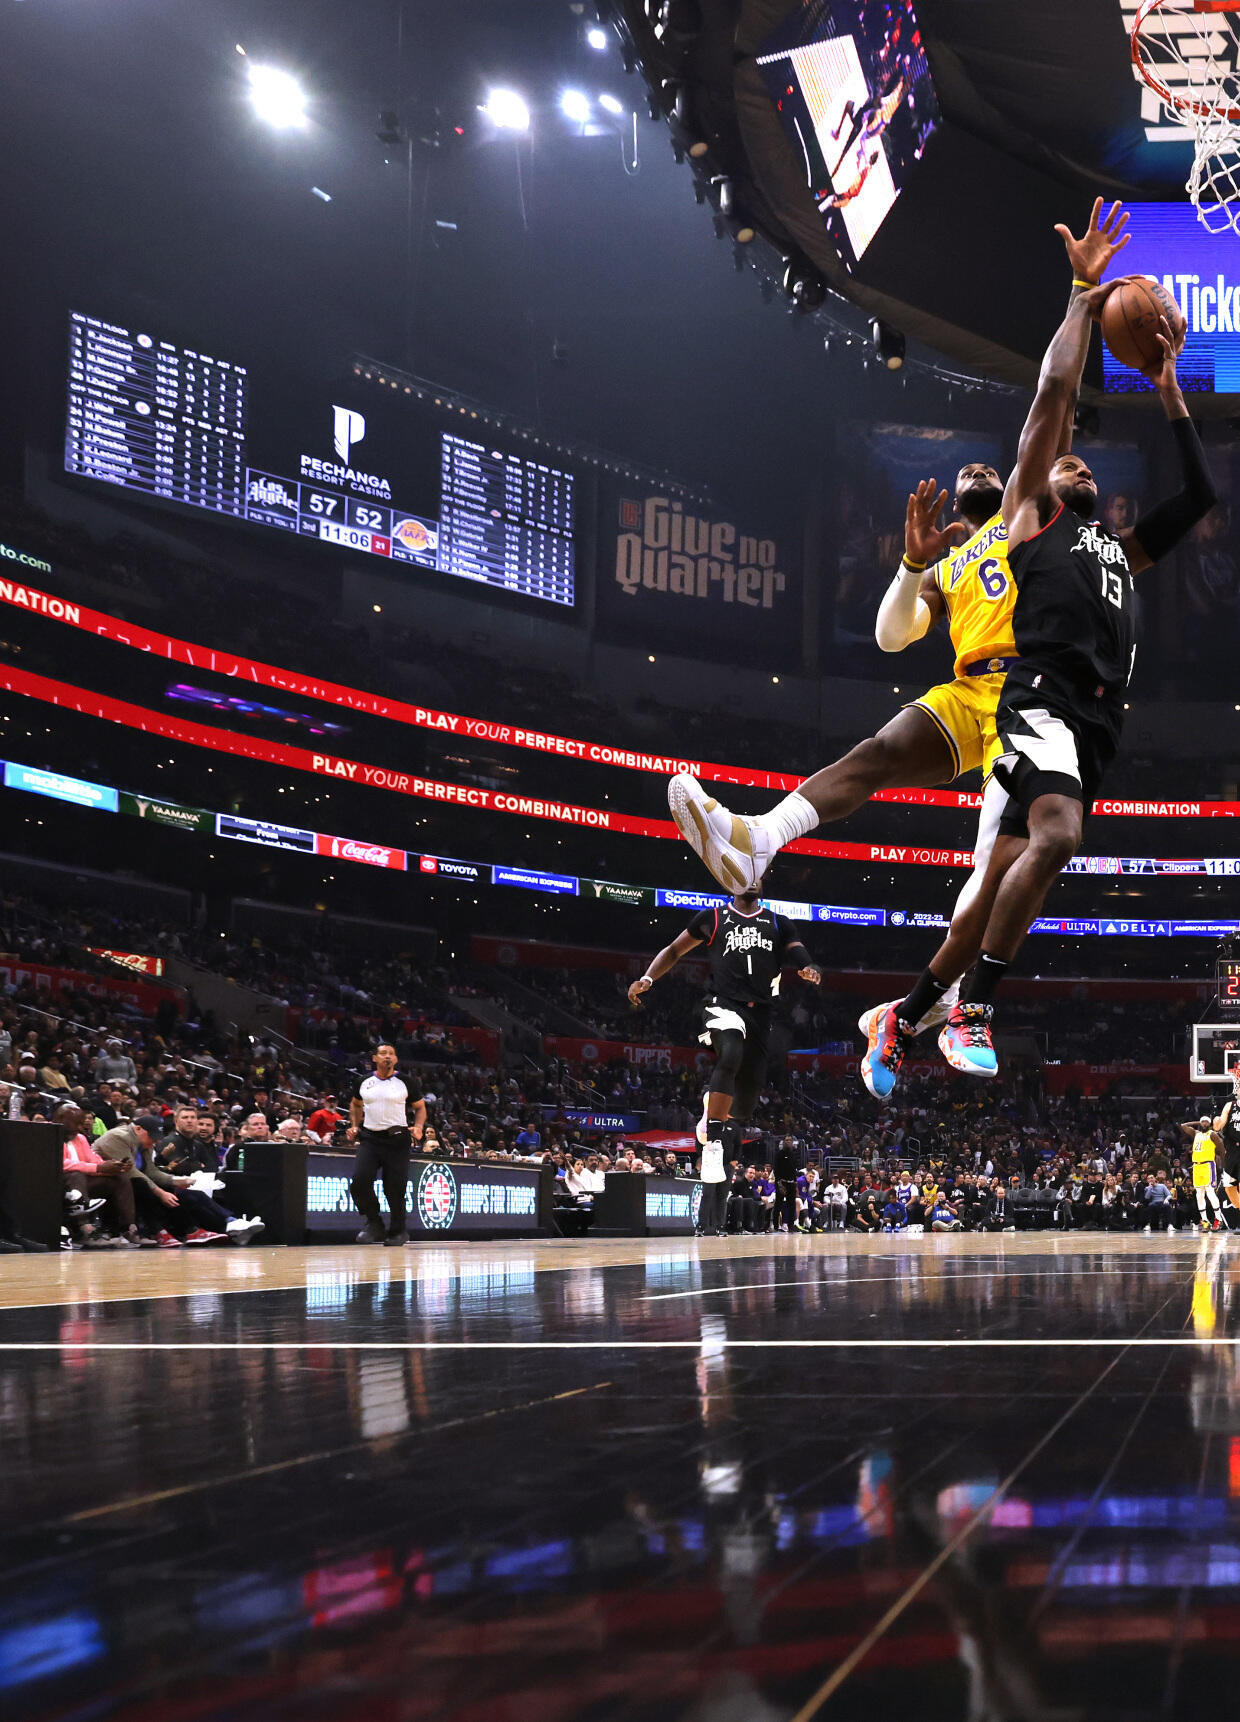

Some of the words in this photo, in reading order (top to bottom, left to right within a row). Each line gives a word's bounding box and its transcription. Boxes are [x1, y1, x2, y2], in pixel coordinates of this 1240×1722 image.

[301, 455, 391, 491] PECHANGA
[301, 467, 344, 486] RESORT
[350, 482, 392, 500] CASINO
[310, 493, 338, 516] 57
[302, 521, 317, 533] 3rd
[355, 507, 383, 530] 52
[322, 525, 370, 548] 11:06
[644, 497, 736, 562] Give
[740, 535, 775, 567] no
[375, 541, 386, 551] 21
[950, 521, 1008, 591] LAKERS
[615, 533, 786, 608] Quarter
[978, 558, 1009, 600] 6
[1101, 566, 1123, 609] 13
[415, 709, 458, 731] PLAY
[465, 720, 510, 742] YOUR
[515, 730, 584, 757] PERFECT
[590, 746, 701, 777] COMBINATION
[313, 756, 357, 779] PLAY
[364, 766, 409, 790] YOUR
[413, 779, 489, 806] PERFECT
[494, 795, 610, 827] COMBINATION
[958, 794, 984, 807] PLA
[1103, 802, 1200, 815] COMBINATION
[871, 847, 906, 861] PLAY
[912, 849, 950, 863] YOUR
[438, 863, 479, 876] TOYOTA
[1129, 861, 1146, 873] 57
[1162, 863, 1200, 874] Clippers
[498, 872, 538, 885] AMERICAN
[539, 877, 573, 889] EXPRESS
[665, 892, 724, 908] Spectrum
[831, 910, 877, 922] crypto.com
[906, 919, 916, 927] LA
[917, 920, 950, 928] CLIPPERS
[914, 912, 944, 922] 2022-23
[733, 925, 757, 937] Los
[1067, 922, 1097, 931] ULTRA
[1121, 923, 1165, 933] DELTA
[723, 931, 773, 956] Angeles
[747, 954, 752, 975] 1
[594, 1117, 625, 1127] ULTRA
[307, 1176, 349, 1212] HOOPS
[461, 1183, 490, 1214] HOOPS
[490, 1185, 505, 1214] FOR
[506, 1186, 535, 1215] TROOPS
